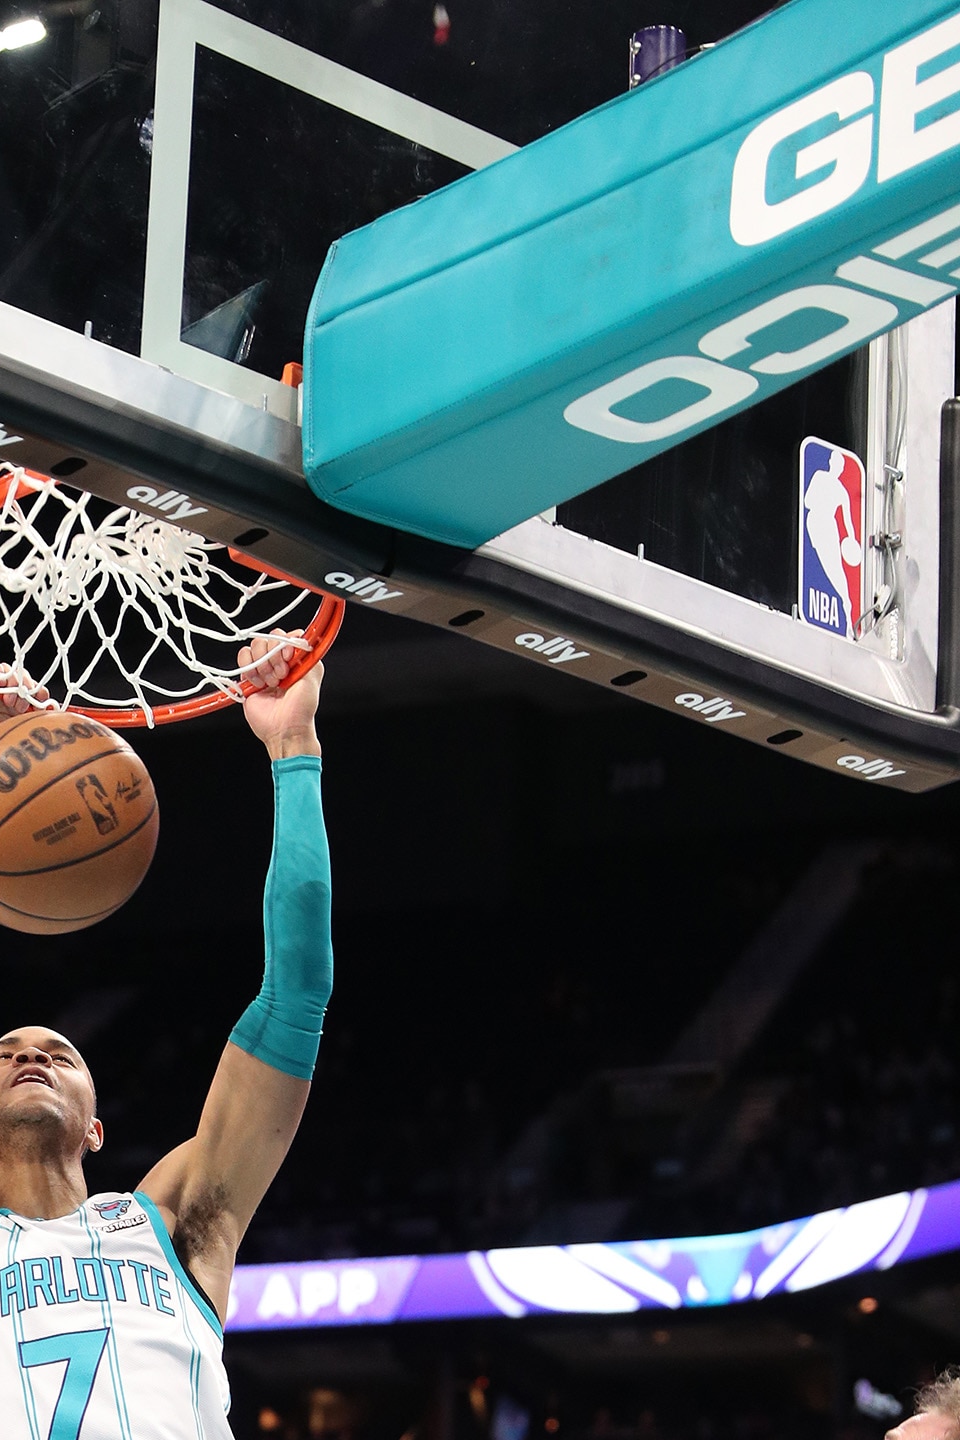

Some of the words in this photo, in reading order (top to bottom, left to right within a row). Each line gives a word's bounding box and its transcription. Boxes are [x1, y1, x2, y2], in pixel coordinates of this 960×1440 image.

[126, 484, 207, 522] ally
[324, 570, 403, 602] ally
[808, 588, 840, 629] NBA
[514, 631, 590, 664] ally
[674, 691, 746, 724] ally
[836, 753, 907, 782] ally
[256, 1267, 378, 1319] APP
